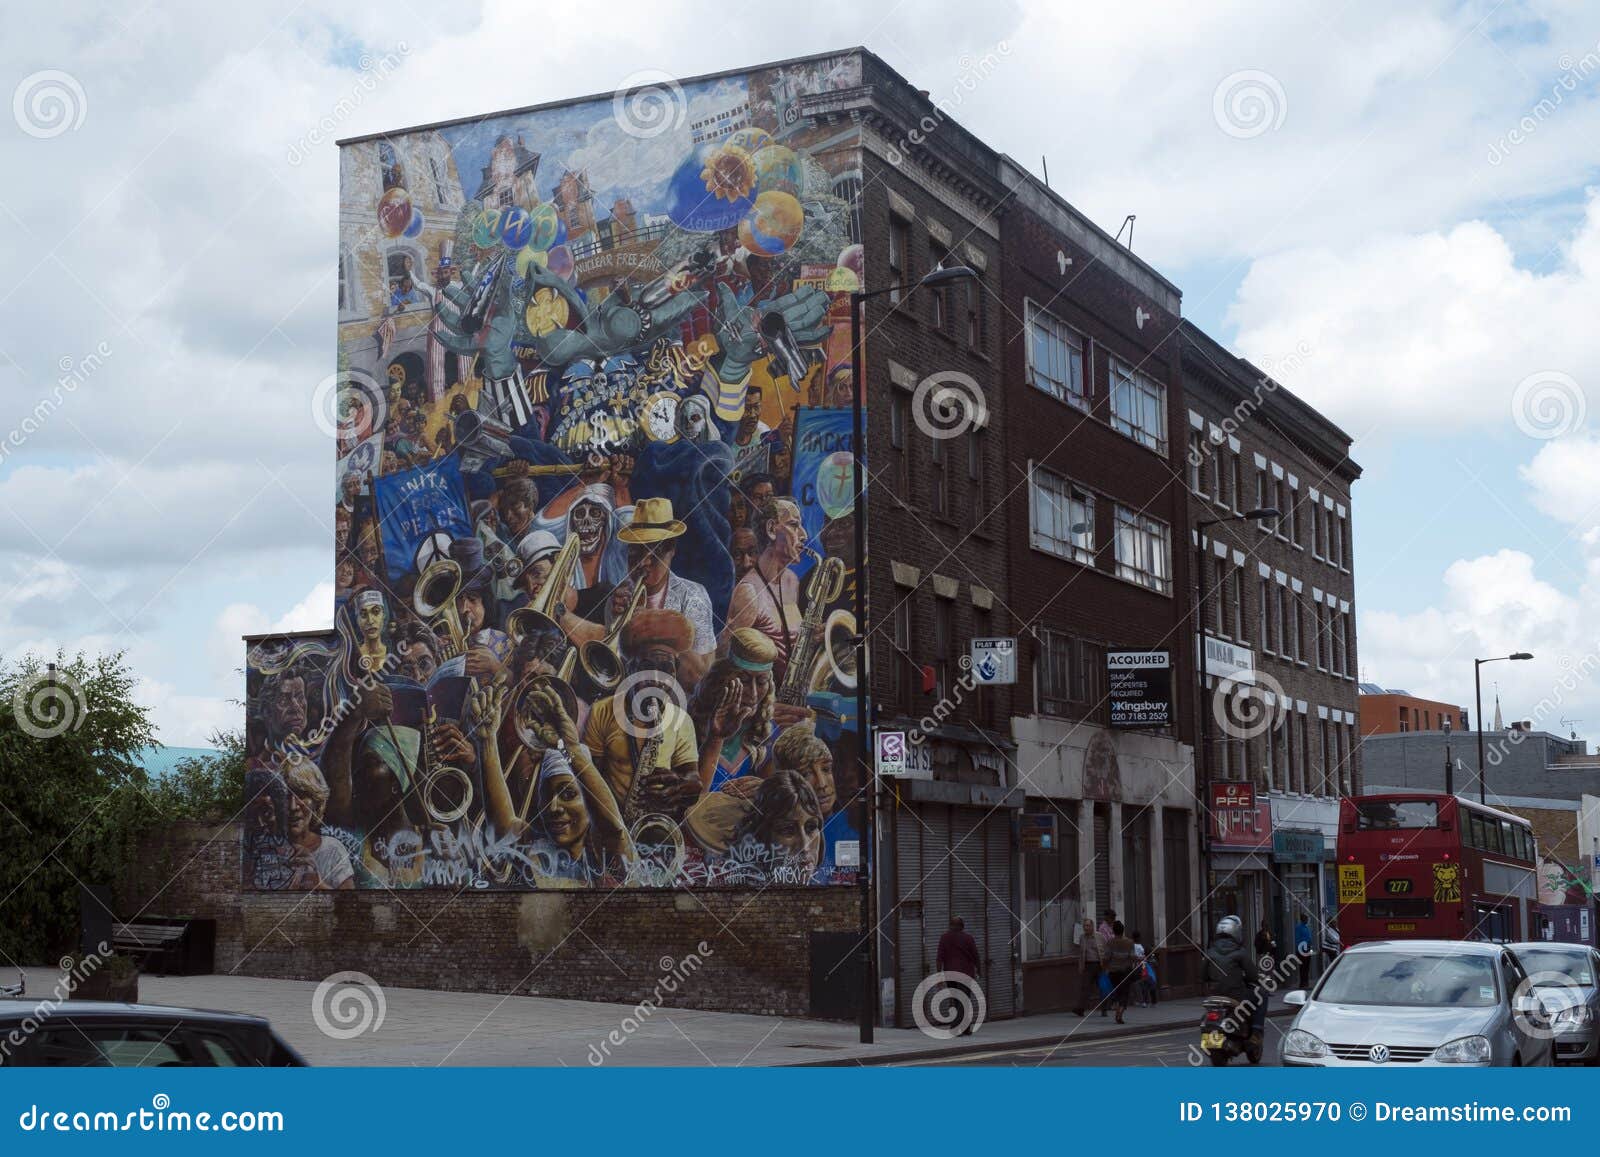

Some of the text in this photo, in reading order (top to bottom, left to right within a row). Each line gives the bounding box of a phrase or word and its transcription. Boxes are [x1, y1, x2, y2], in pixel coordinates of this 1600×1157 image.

[575, 253, 613, 273] NUCLEAR
[616, 253, 637, 267] FREE
[1109, 655, 1165, 665] ACQUIRED
[1116, 700, 1168, 712] Kingsbury
[1111, 711, 1168, 721] 020 7183 2529
[1215, 797, 1249, 806] PFC
[1390, 880, 1409, 892] 277
[1342, 889, 1363, 897] KING
